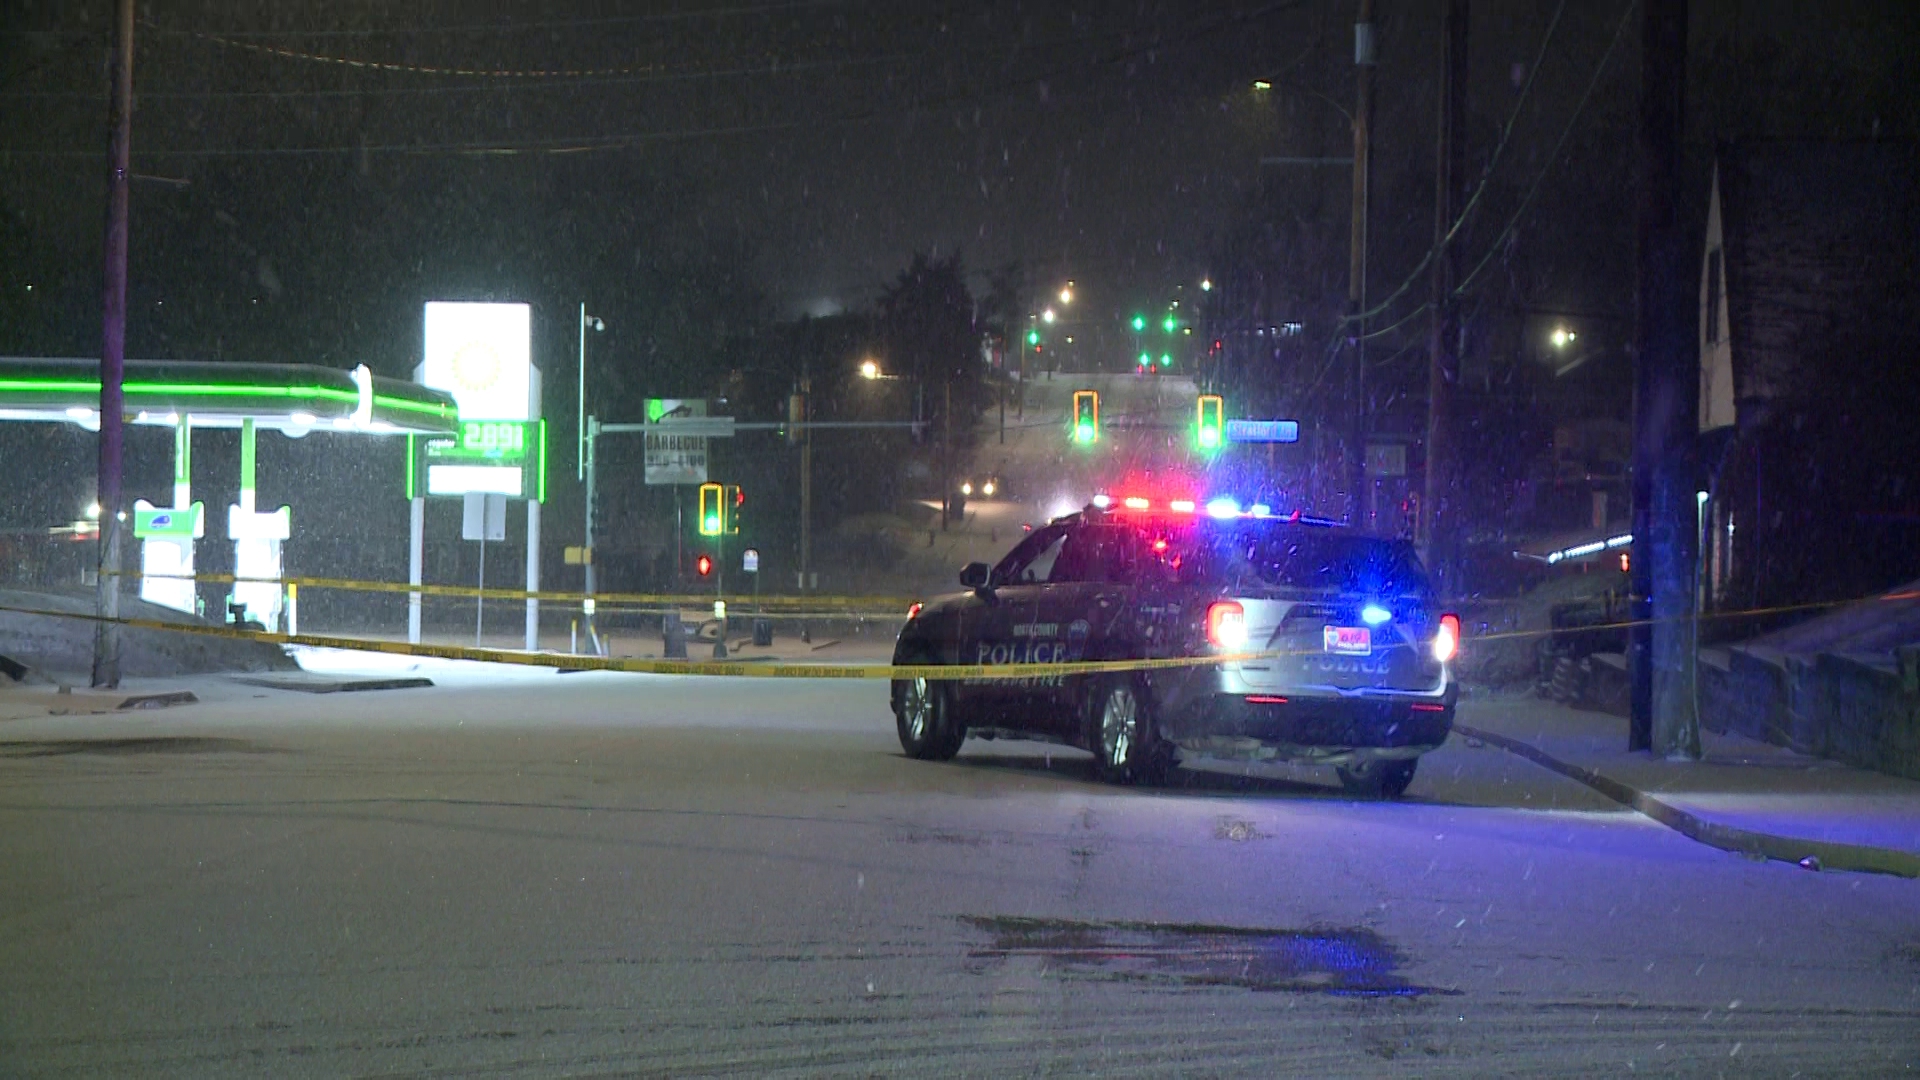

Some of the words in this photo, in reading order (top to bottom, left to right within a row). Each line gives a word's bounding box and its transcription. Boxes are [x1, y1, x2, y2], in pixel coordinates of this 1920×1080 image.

[646, 434, 705, 451] BARBECUE
[1034, 623, 1058, 636] COUNTY
[977, 640, 1067, 665] POLICE
